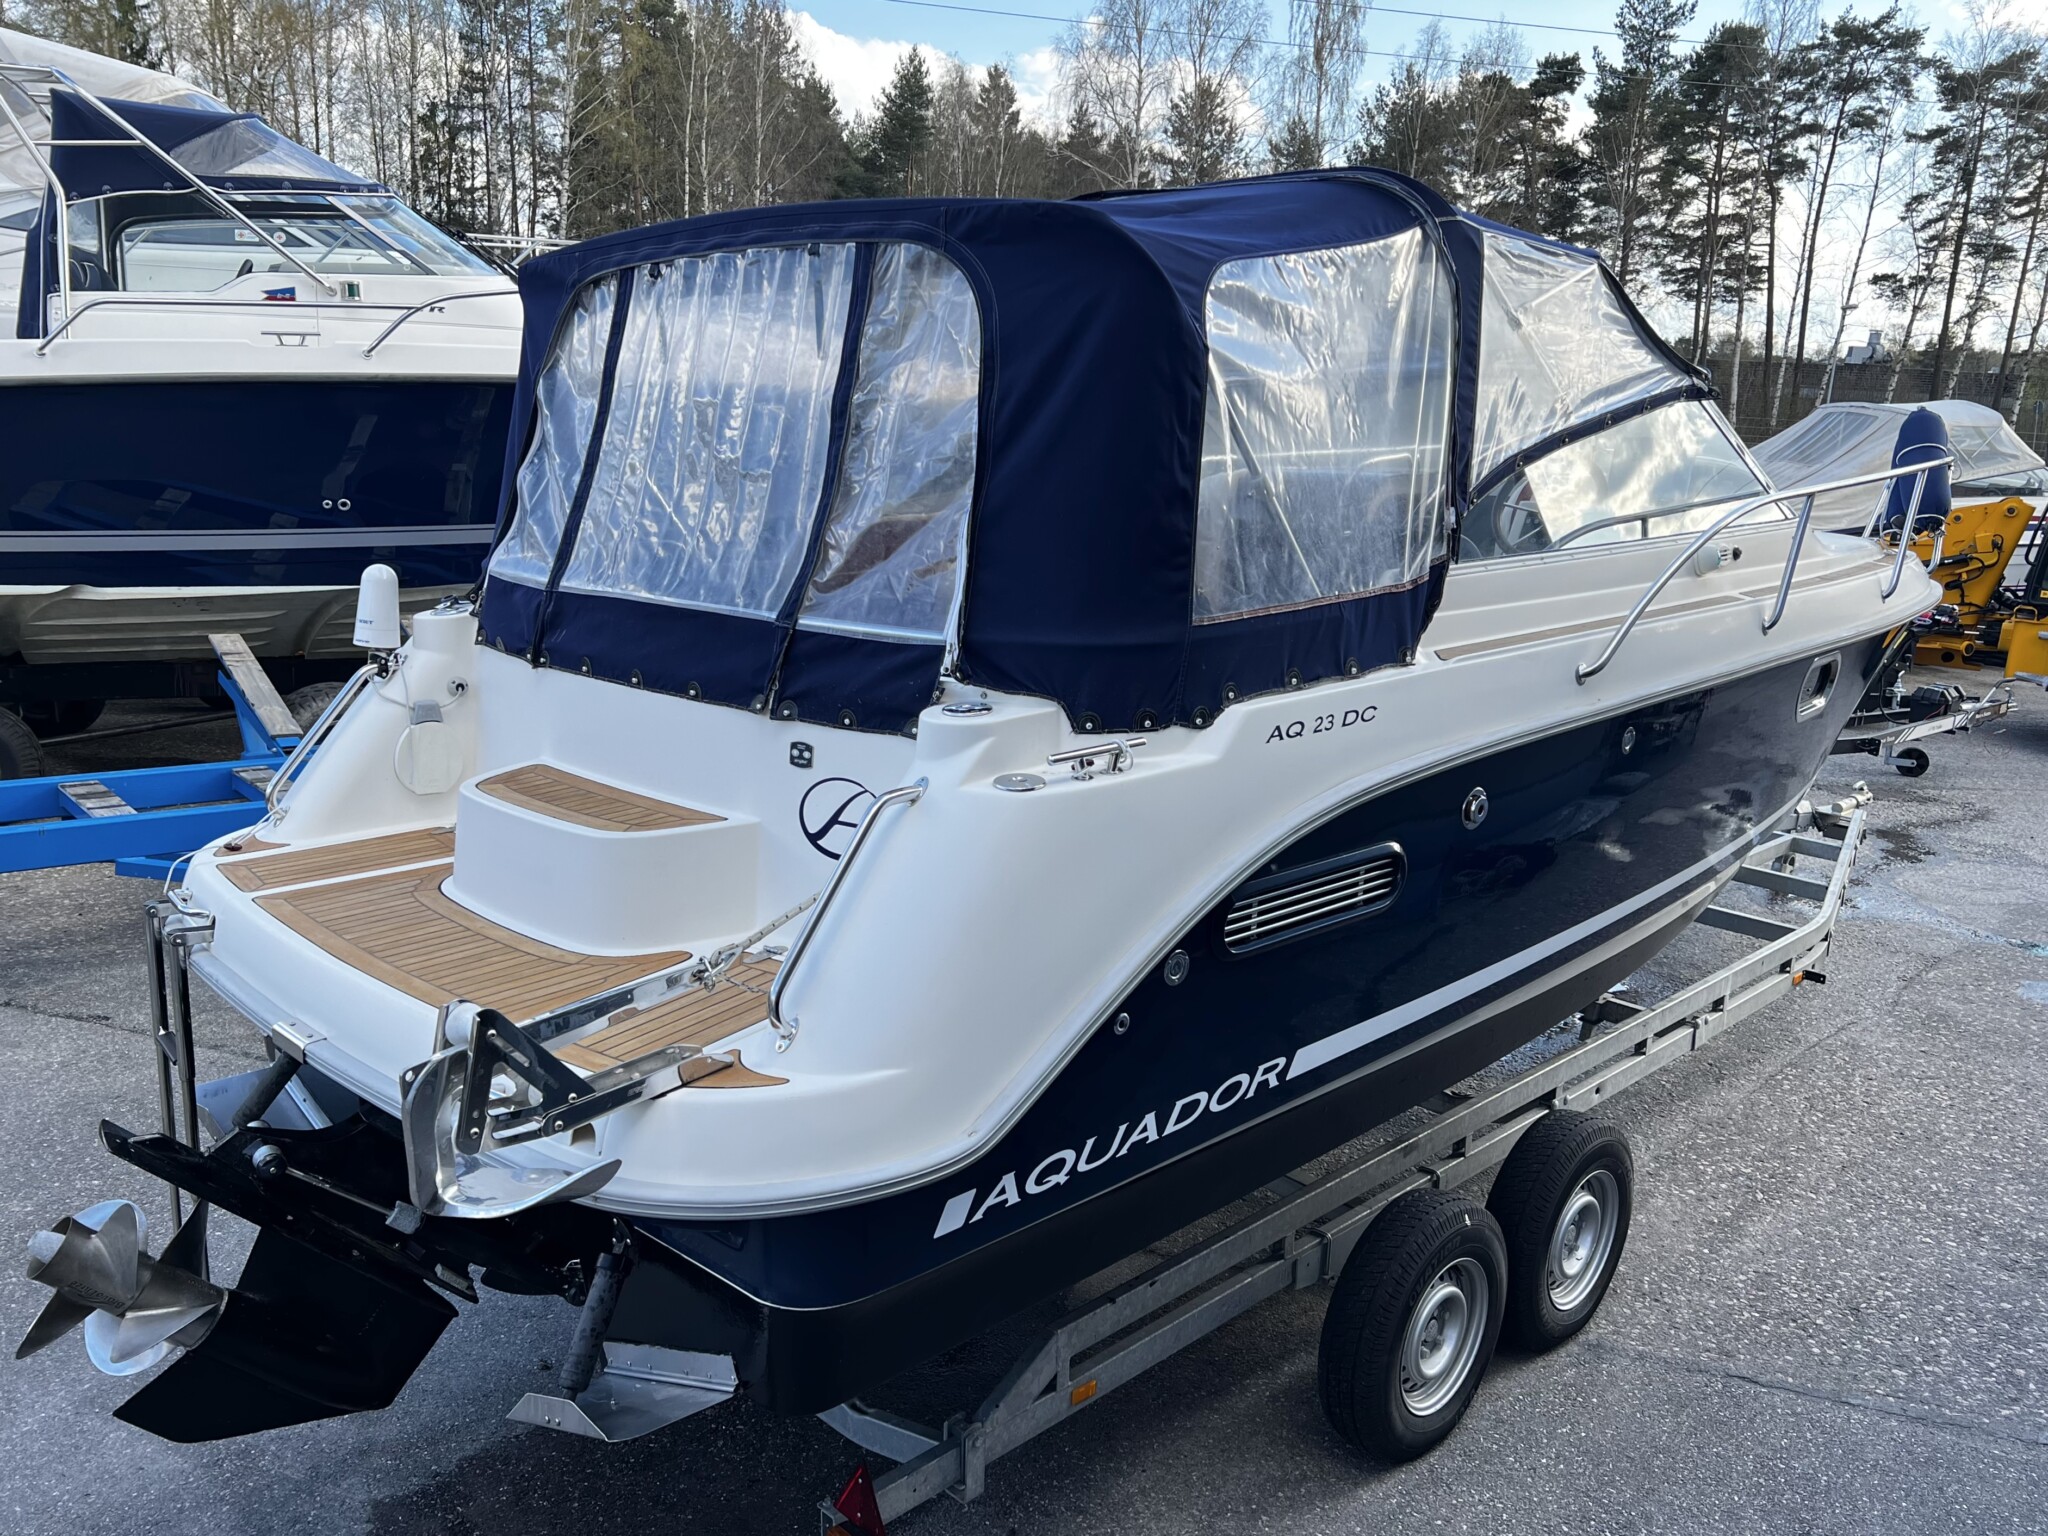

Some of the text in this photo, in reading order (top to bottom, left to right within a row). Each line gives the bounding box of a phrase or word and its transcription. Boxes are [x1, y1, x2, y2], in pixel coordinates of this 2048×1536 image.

[1265, 705, 1378, 744] AQ 23 DC
[969, 1057, 1287, 1224] AQUADOR
